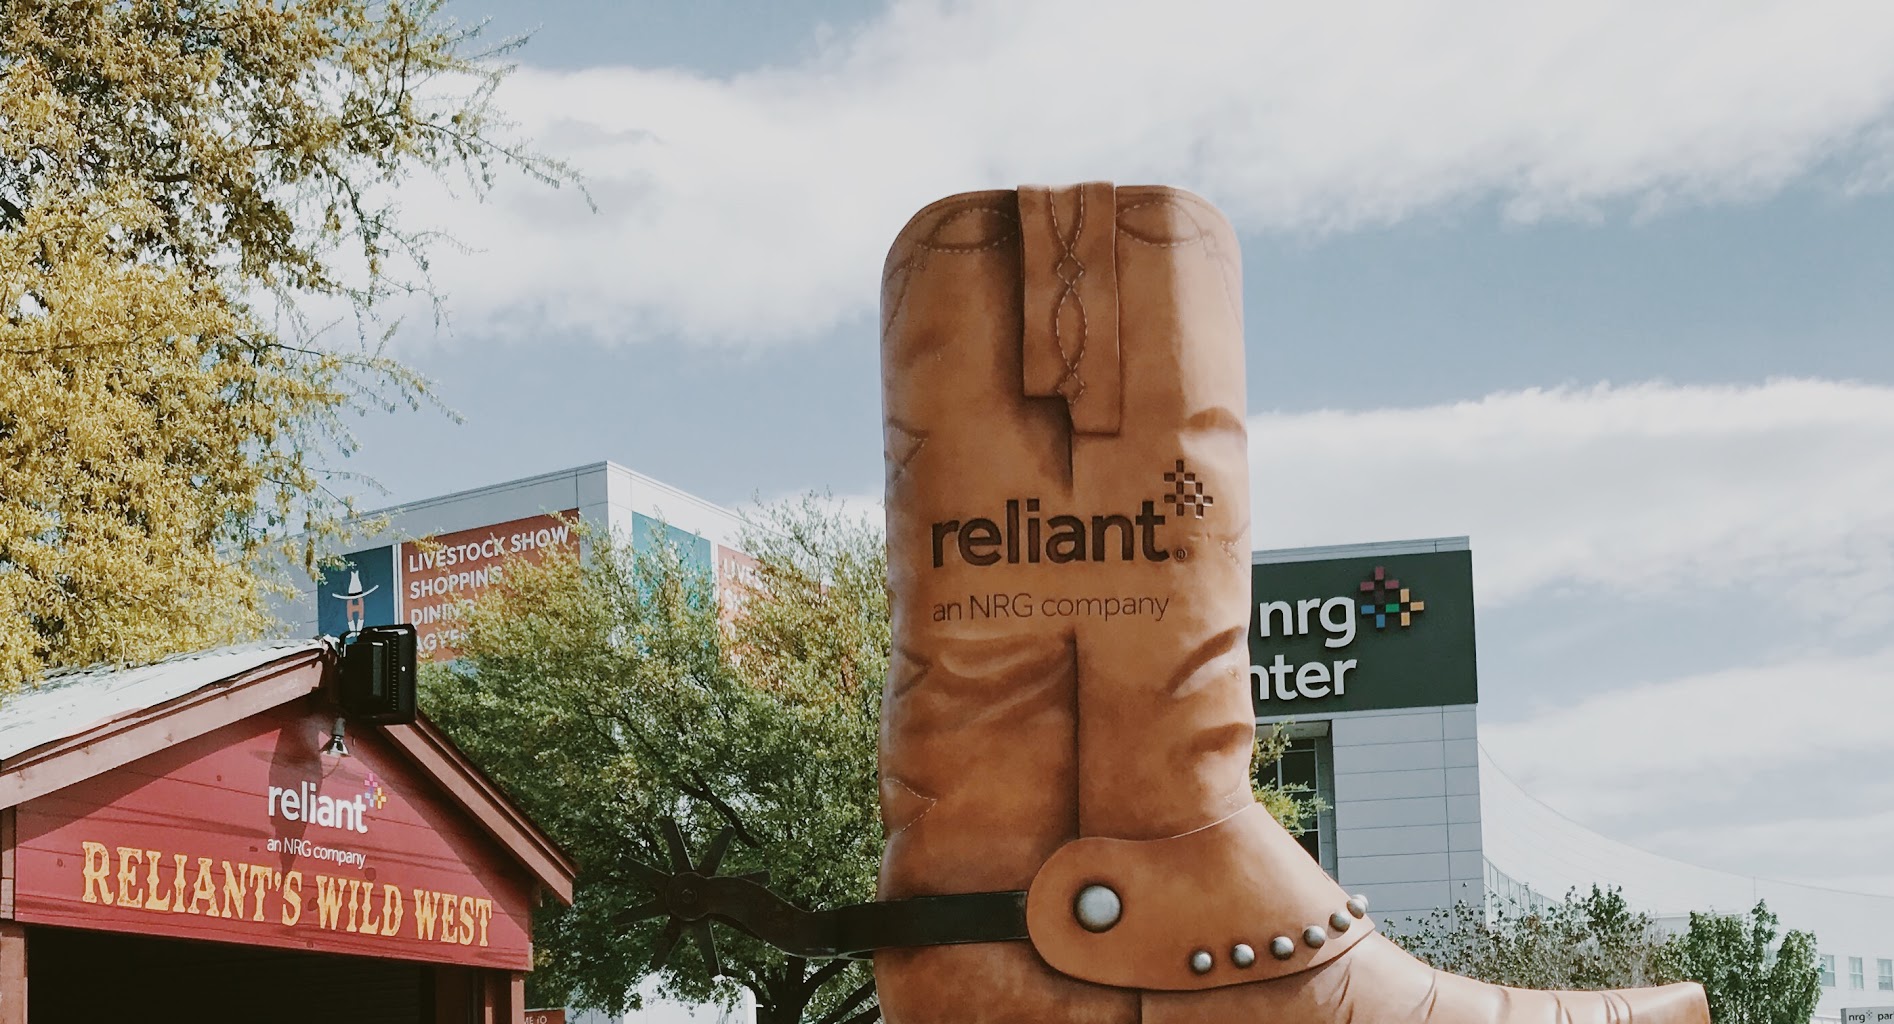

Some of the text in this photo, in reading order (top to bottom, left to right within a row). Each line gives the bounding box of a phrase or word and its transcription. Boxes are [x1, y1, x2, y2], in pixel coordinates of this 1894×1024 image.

[408, 525, 570, 573] LIVESTOCK SHOW
[409, 565, 503, 600] SHOPPING
[932, 592, 1170, 623] an NRG company
[1259, 596, 1357, 649] nrg
[1249, 654, 1358, 701] nter
[268, 780, 369, 834] reliant
[266, 837, 367, 870] an NRG company
[81, 841, 493, 947] RELIANT'S WILD WEST
[1848, 1012, 1894, 1024] nrg par
